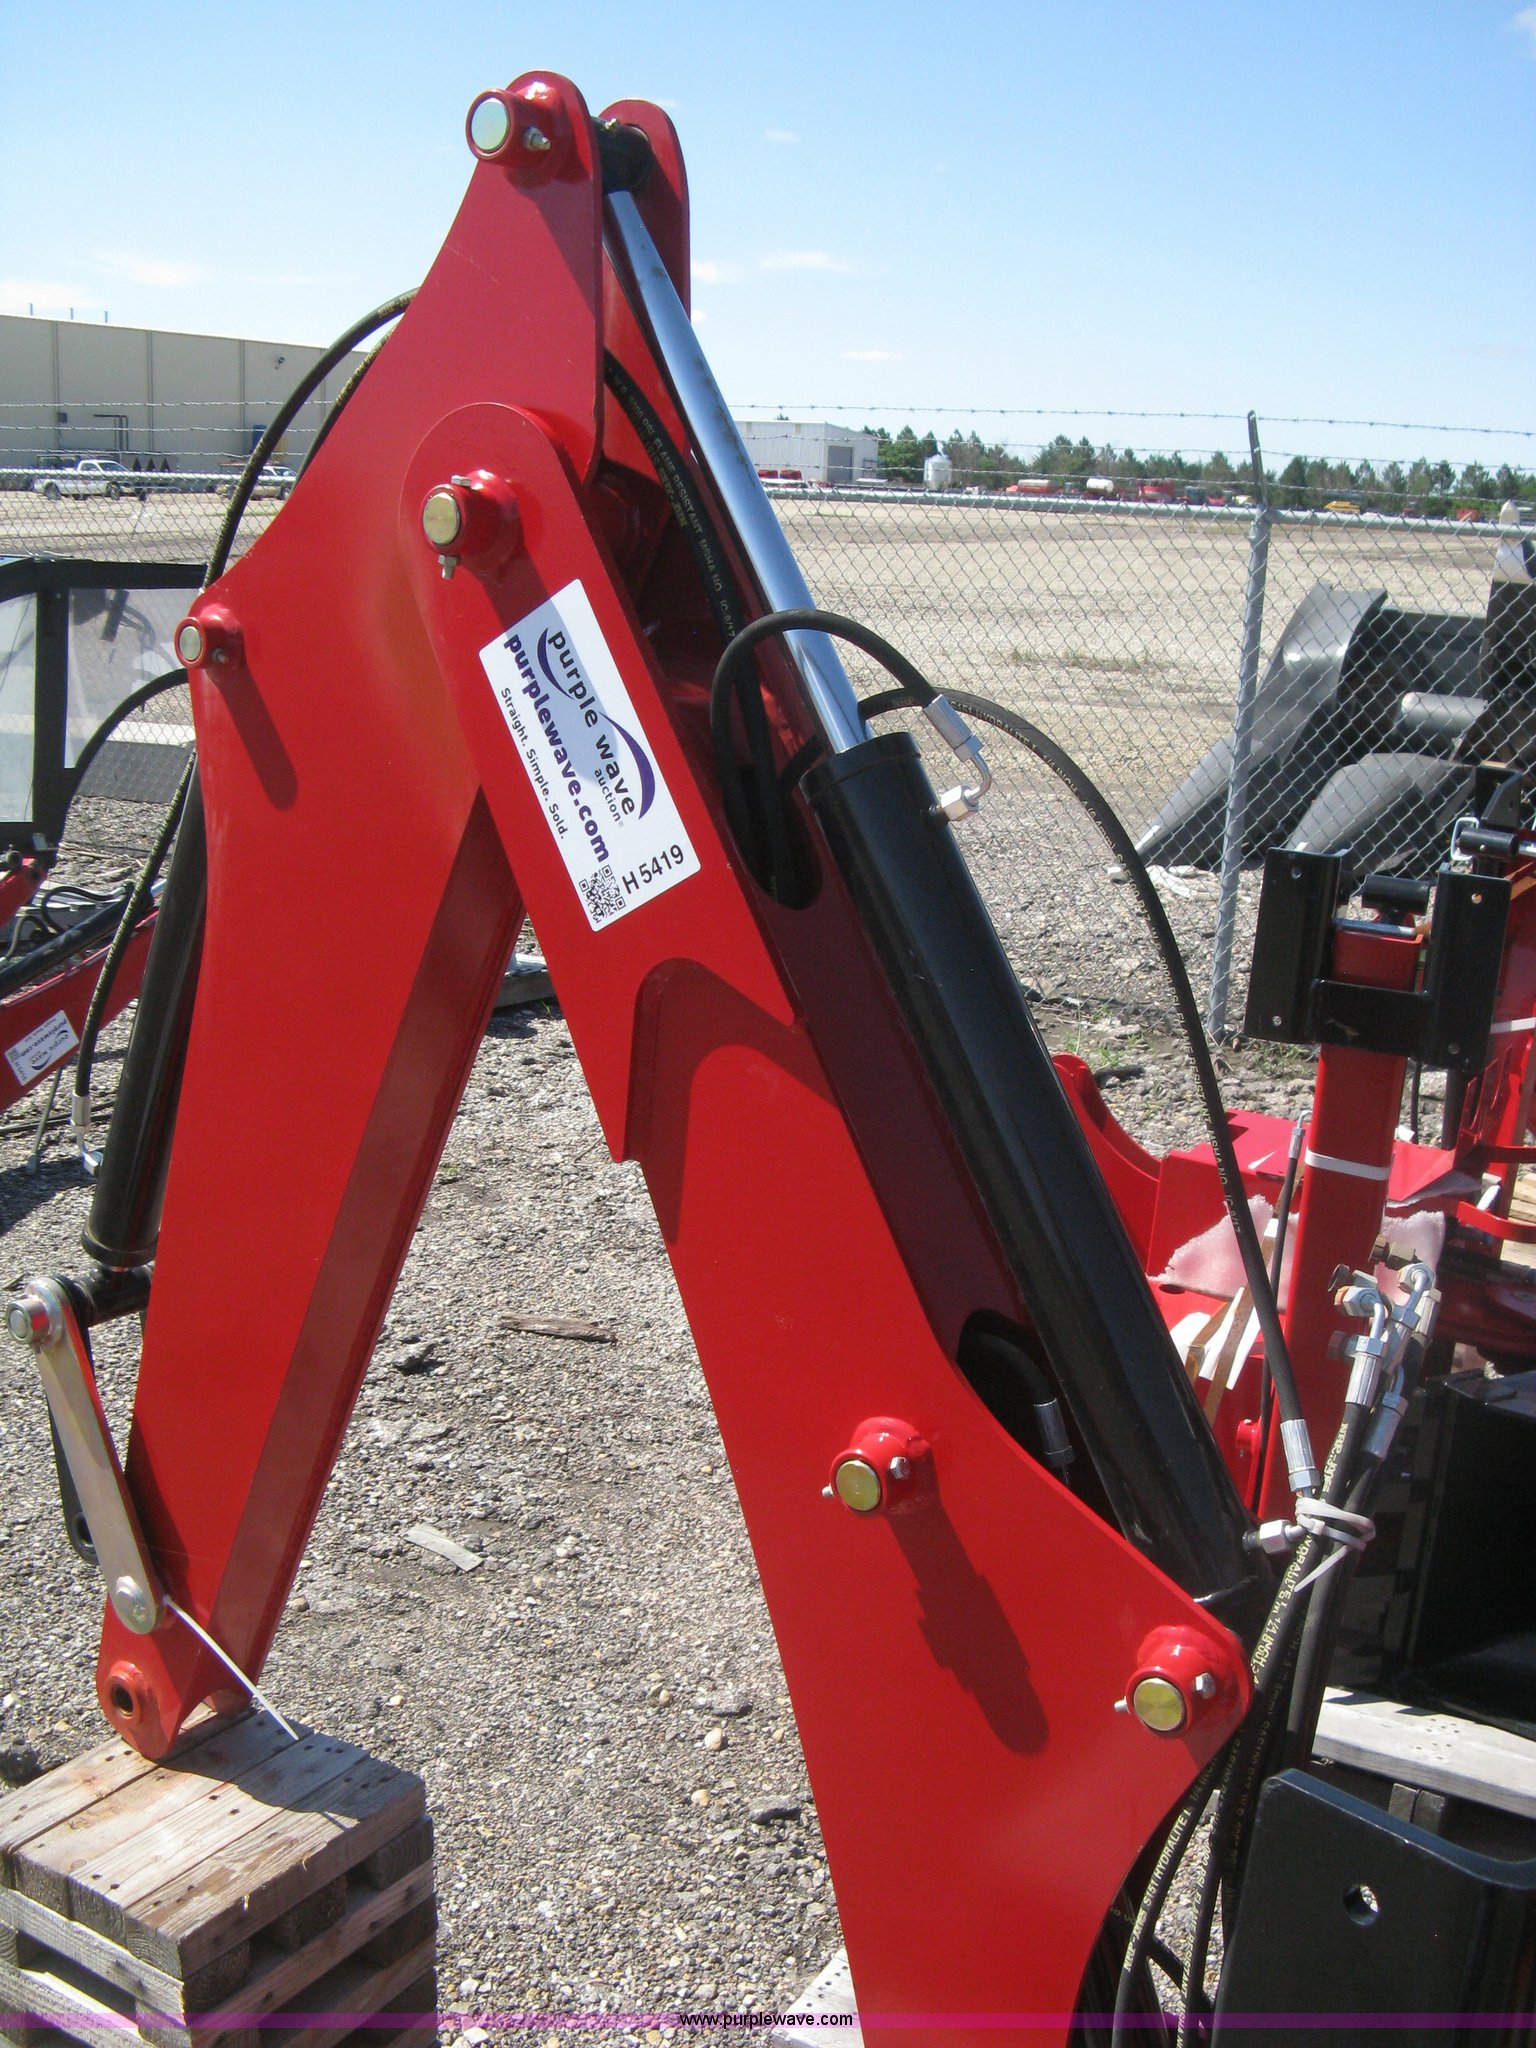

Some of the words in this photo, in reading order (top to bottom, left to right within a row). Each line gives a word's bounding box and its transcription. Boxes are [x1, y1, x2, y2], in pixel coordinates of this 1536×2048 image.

[671, 474, 703, 534] RESISTANT
[711, 573, 723, 592] NO
[500, 687, 527, 747] Straight.
[525, 748, 549, 802] Simple.
[548, 803, 568, 840] Sold.
[503, 634, 610, 863] purplewave.com
[547, 630, 599, 728] purple
[595, 733, 636, 816] wave
[593, 768, 621, 823] auction
[1282, 1534, 1313, 1599] YDRALITE
[1142, 1879, 1159, 1906] S151
[1152, 1814, 1187, 1879] HYDRALITE
[1179, 1933, 1194, 1998] RESISTANT
